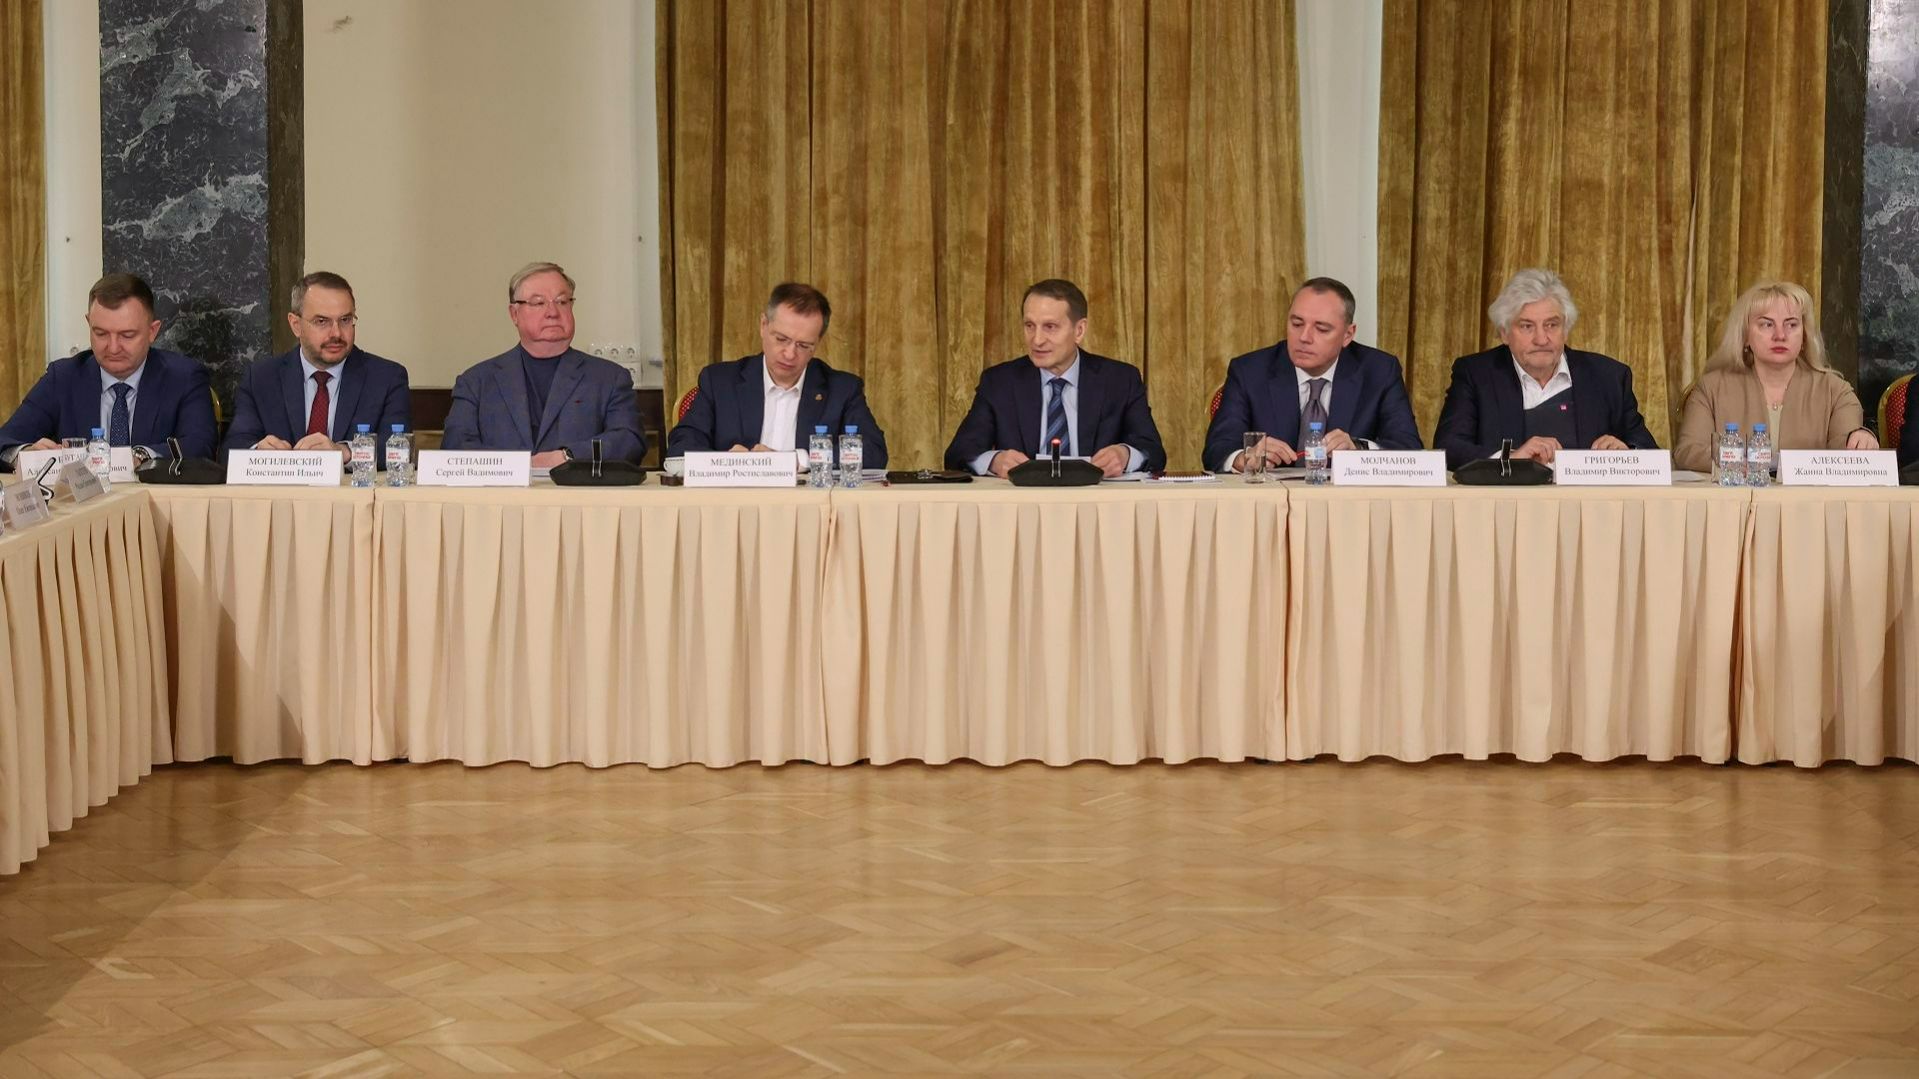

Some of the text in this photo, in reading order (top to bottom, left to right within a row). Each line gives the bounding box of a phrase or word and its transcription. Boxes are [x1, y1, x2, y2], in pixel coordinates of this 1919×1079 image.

[248, 456, 323, 467] МОГИЛЕВСКИЙ
[446, 457, 503, 466] СТЕПАШИН
[710, 457, 772, 467] МЕДИНСКИЙ
[1360, 456, 1416, 465] МОЛЧАНОВ
[1584, 455, 1640, 465] ГРИГОРЬЕВ
[1810, 455, 1870, 465] АЛЕКСЕЕВА
[245, 468, 324, 478] Константин Ильич
[435, 468, 514, 478] Сергей Вадимович
[688, 469, 794, 479] Владимир Ростиславович
[1343, 467, 1434, 477] Денис Владимирович
[1564, 467, 1661, 477] Владимир Викторович
[1793, 467, 1888, 478] Жанна Владимировна
